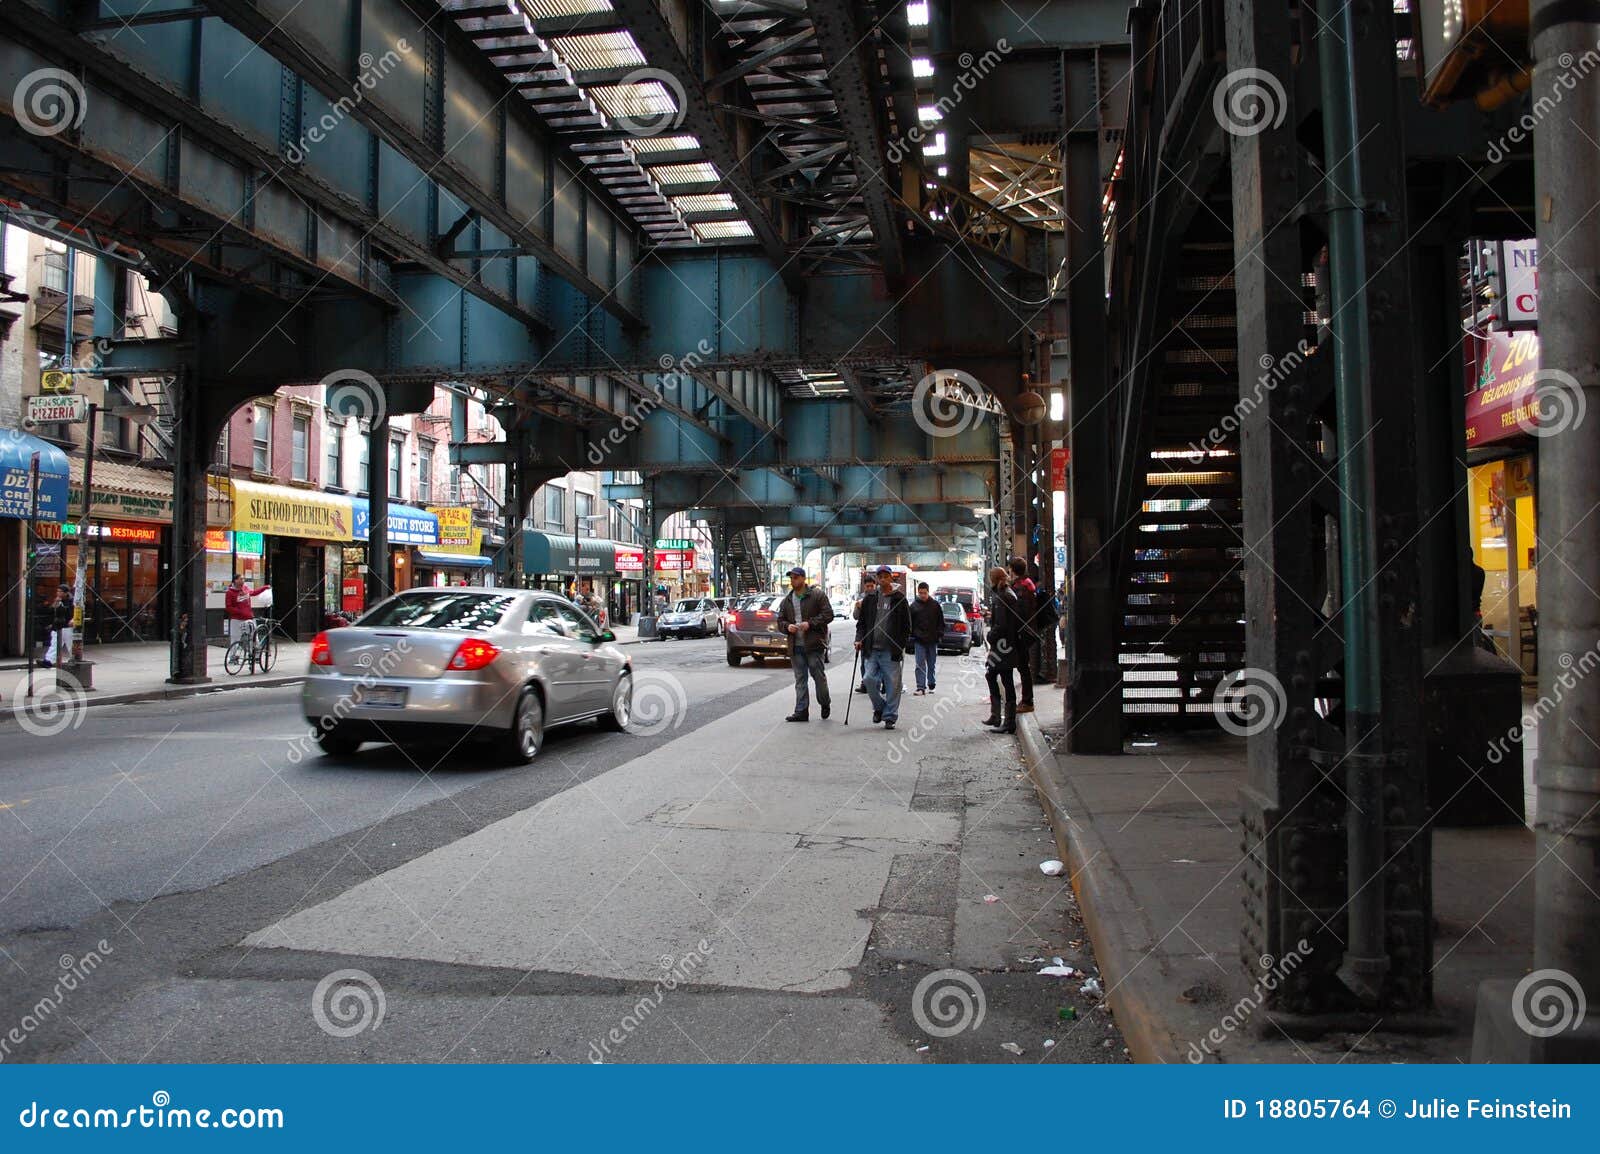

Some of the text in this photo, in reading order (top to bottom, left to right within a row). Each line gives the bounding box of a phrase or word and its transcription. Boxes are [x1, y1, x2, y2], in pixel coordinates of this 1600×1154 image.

[32, 406, 75, 419] PIZZERIA
[1502, 410, 1516, 428] FREE
[250, 499, 330, 526] SEAFOOD PREMIUM
[36, 522, 62, 540] ATM
[112, 526, 156, 540] RESTAURANT
[409, 519, 435, 533] STORE
